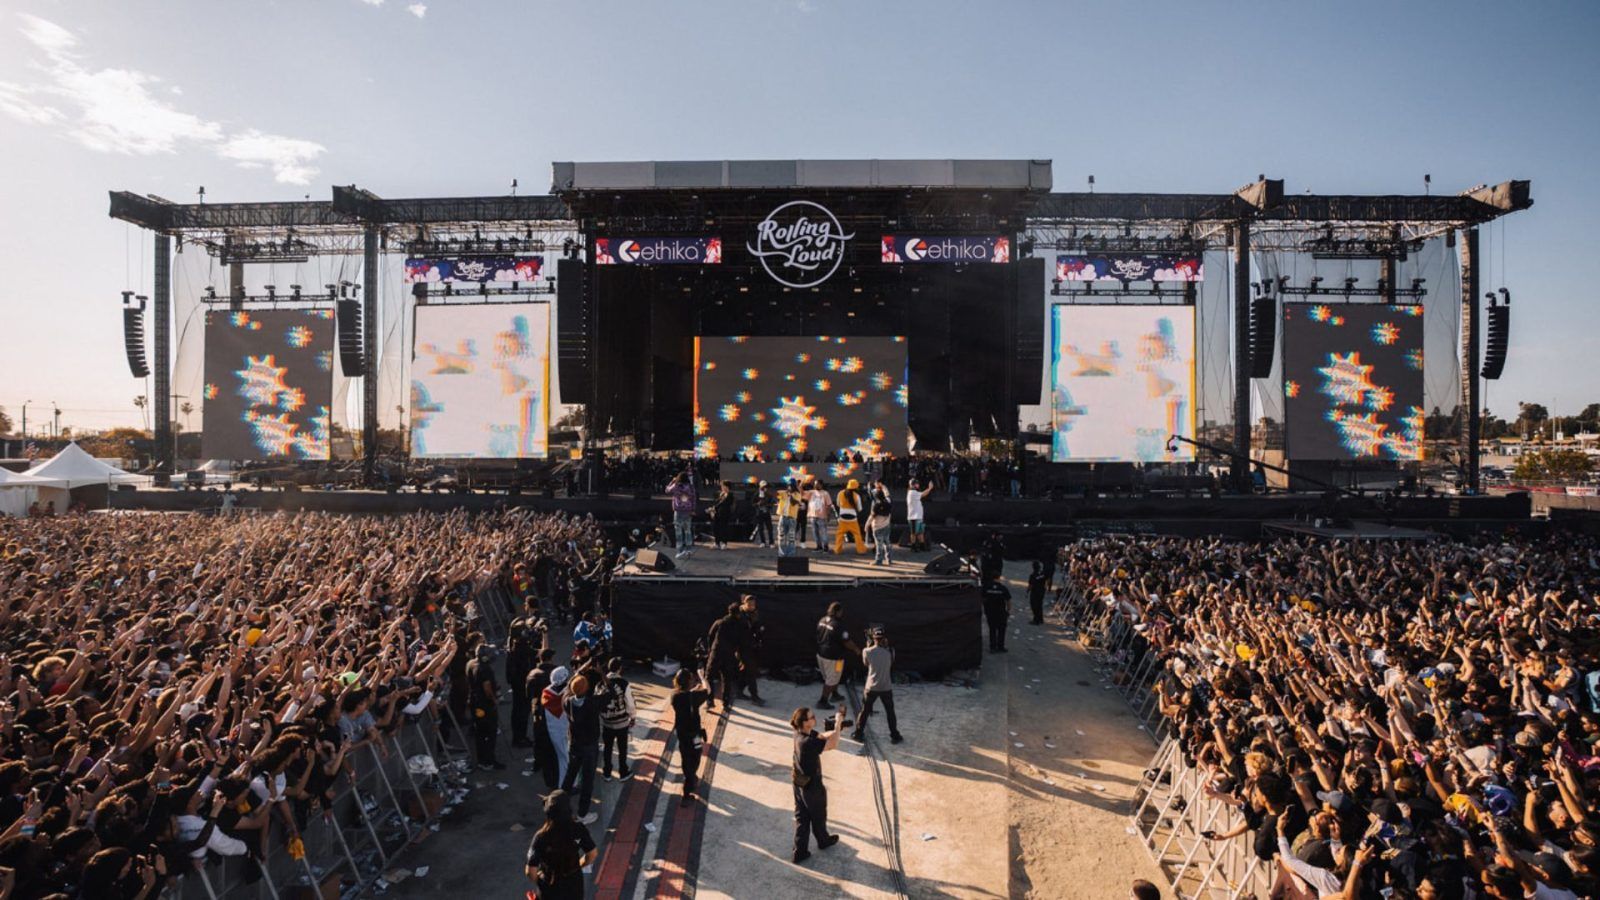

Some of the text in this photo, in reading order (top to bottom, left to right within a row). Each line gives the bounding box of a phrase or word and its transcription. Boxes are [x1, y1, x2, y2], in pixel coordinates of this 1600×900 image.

[757, 217, 855, 249] Rolling
[641, 240, 699, 260] ethika
[746, 241, 836, 270] Loud
[928, 238, 986, 259] ethika
